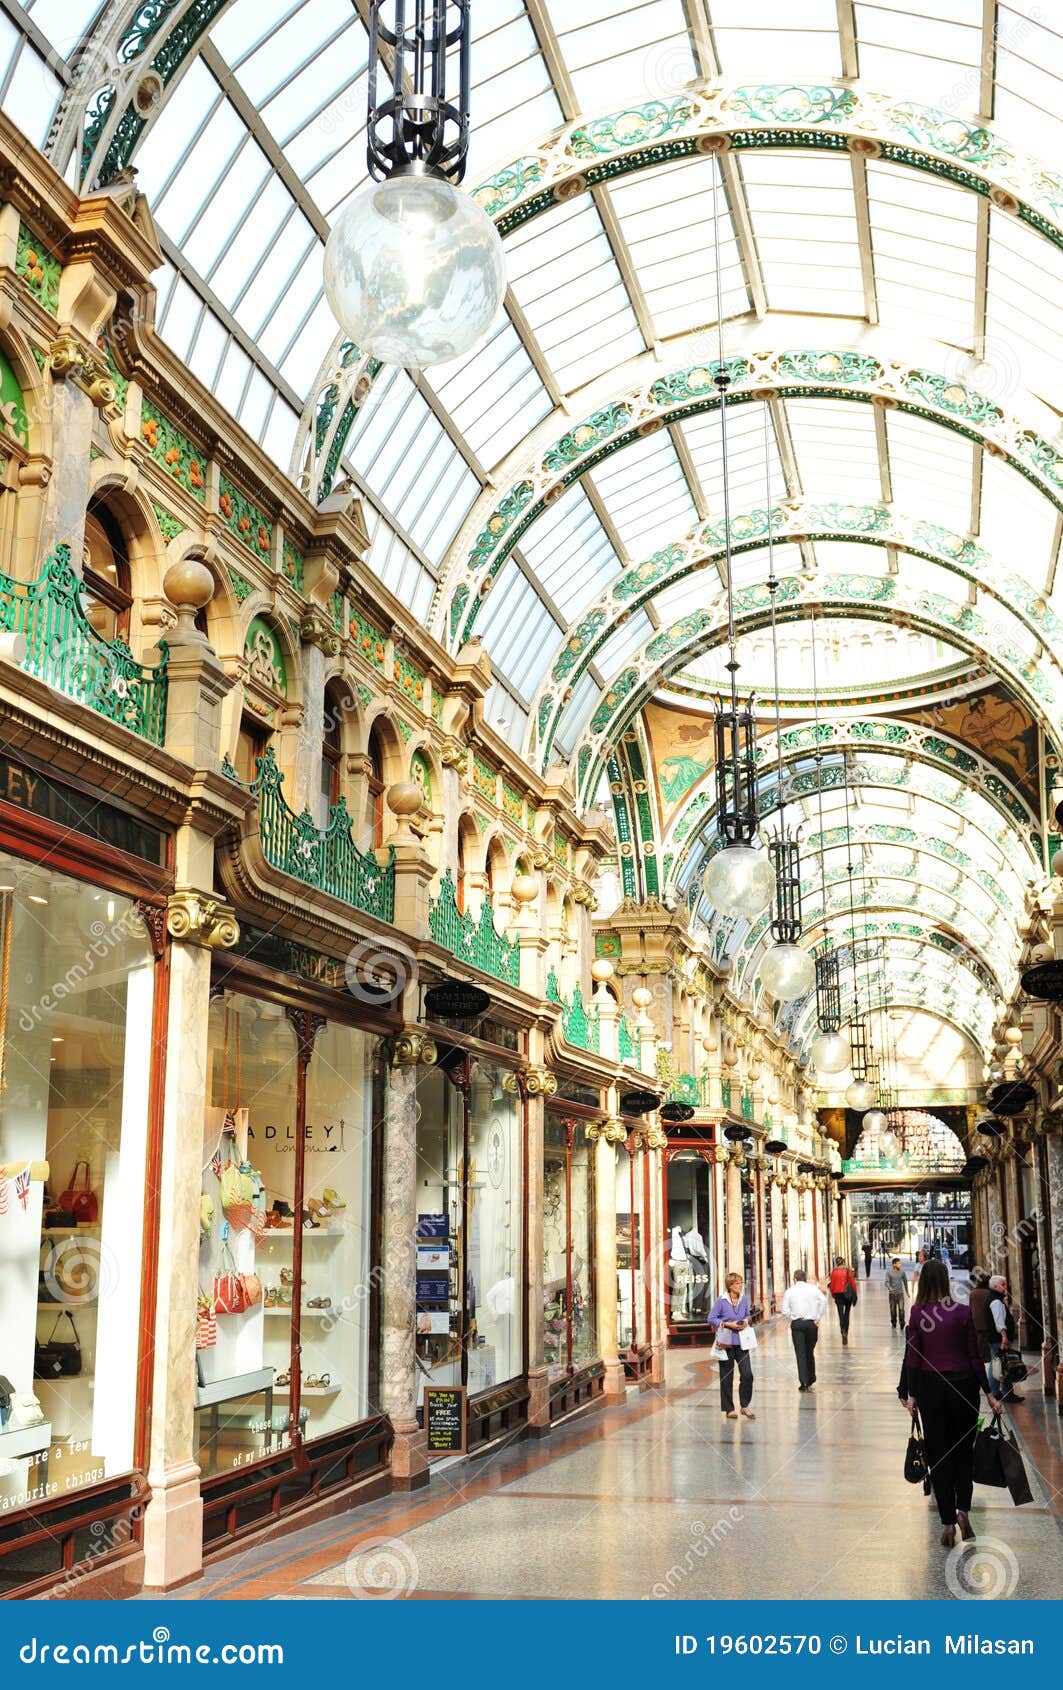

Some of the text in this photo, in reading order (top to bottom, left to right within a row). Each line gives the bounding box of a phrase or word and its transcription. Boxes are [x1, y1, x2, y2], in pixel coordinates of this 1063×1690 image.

[0, 765, 39, 808] EY
[246, 1125, 334, 1139] ADLEY
[676, 1274, 709, 1284] REISS
[28, 1451, 49, 1467] are
[55, 1447, 62, 1460] a
[68, 1439, 89, 1456] few
